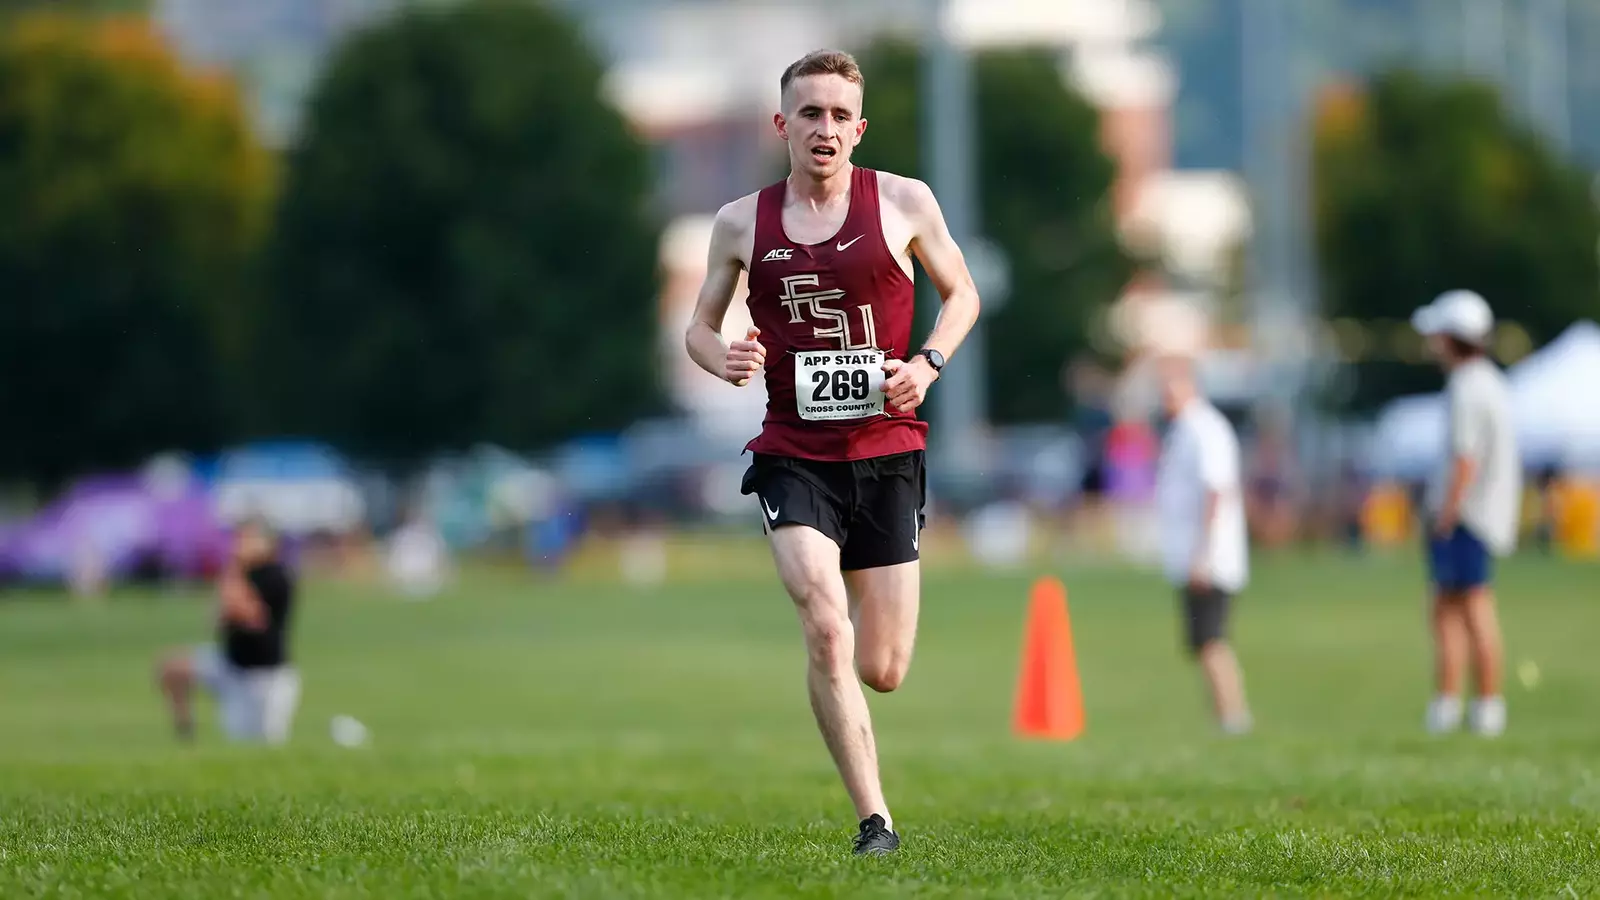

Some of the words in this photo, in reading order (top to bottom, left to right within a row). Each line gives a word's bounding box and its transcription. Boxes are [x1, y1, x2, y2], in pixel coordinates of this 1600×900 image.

[763, 249, 794, 260] ACC
[779, 274, 880, 351] FSU
[804, 356, 831, 366] APP
[835, 354, 876, 365] STATE
[811, 369, 870, 401] 269
[805, 405, 834, 413] CROSS
[836, 402, 876, 411] COUNTRY
